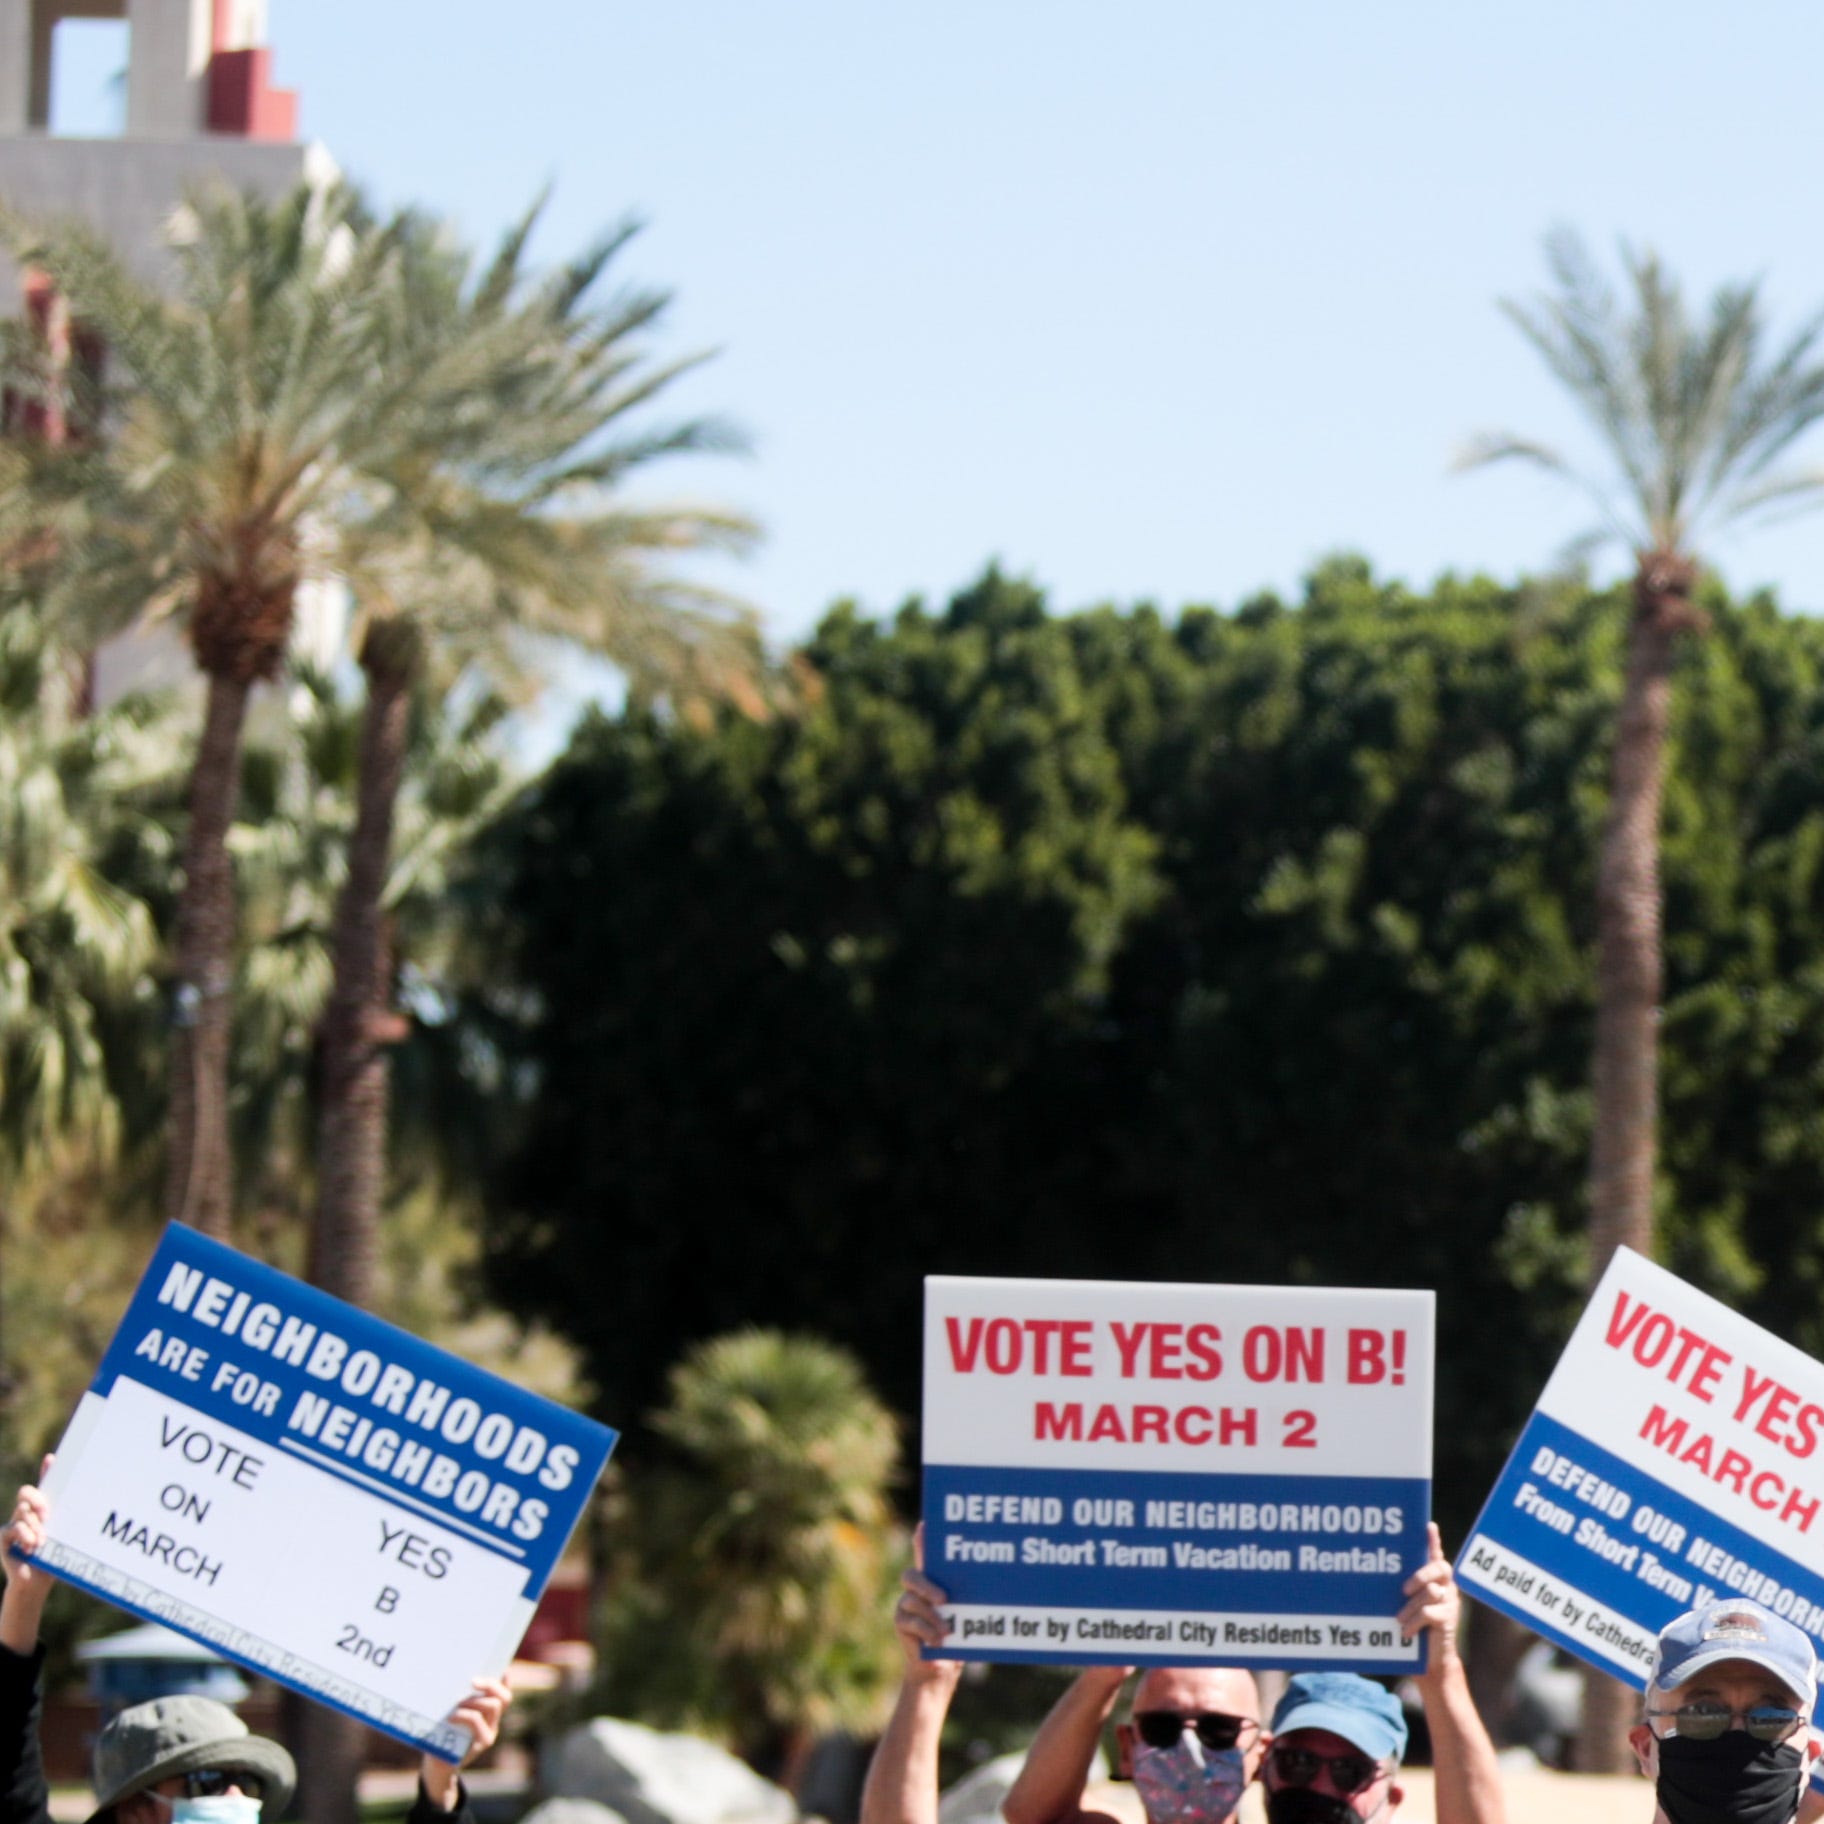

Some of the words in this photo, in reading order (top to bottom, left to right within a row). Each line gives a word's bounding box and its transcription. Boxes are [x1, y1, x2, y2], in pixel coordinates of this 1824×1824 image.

[157, 1261, 580, 1491] NEIGHBORHOODS
[946, 1317, 1094, 1377] VOTE
[1110, 1322, 1223, 1382] YES
[1242, 1326, 1324, 1384] ON
[1347, 1329, 1406, 1386] B!
[1603, 1290, 1732, 1404] VOTE
[135, 1328, 208, 1380] ARE
[211, 1362, 282, 1417] FOR
[288, 1392, 549, 1541] NEIGHBORS
[160, 1415, 265, 1491] VOTE
[378, 1520, 454, 1581] YES
[101, 1511, 224, 1586] MARCH
[335, 1625, 394, 1669] 2nd
[160, 1484, 211, 1525] ON
[374, 1585, 399, 1616] B
